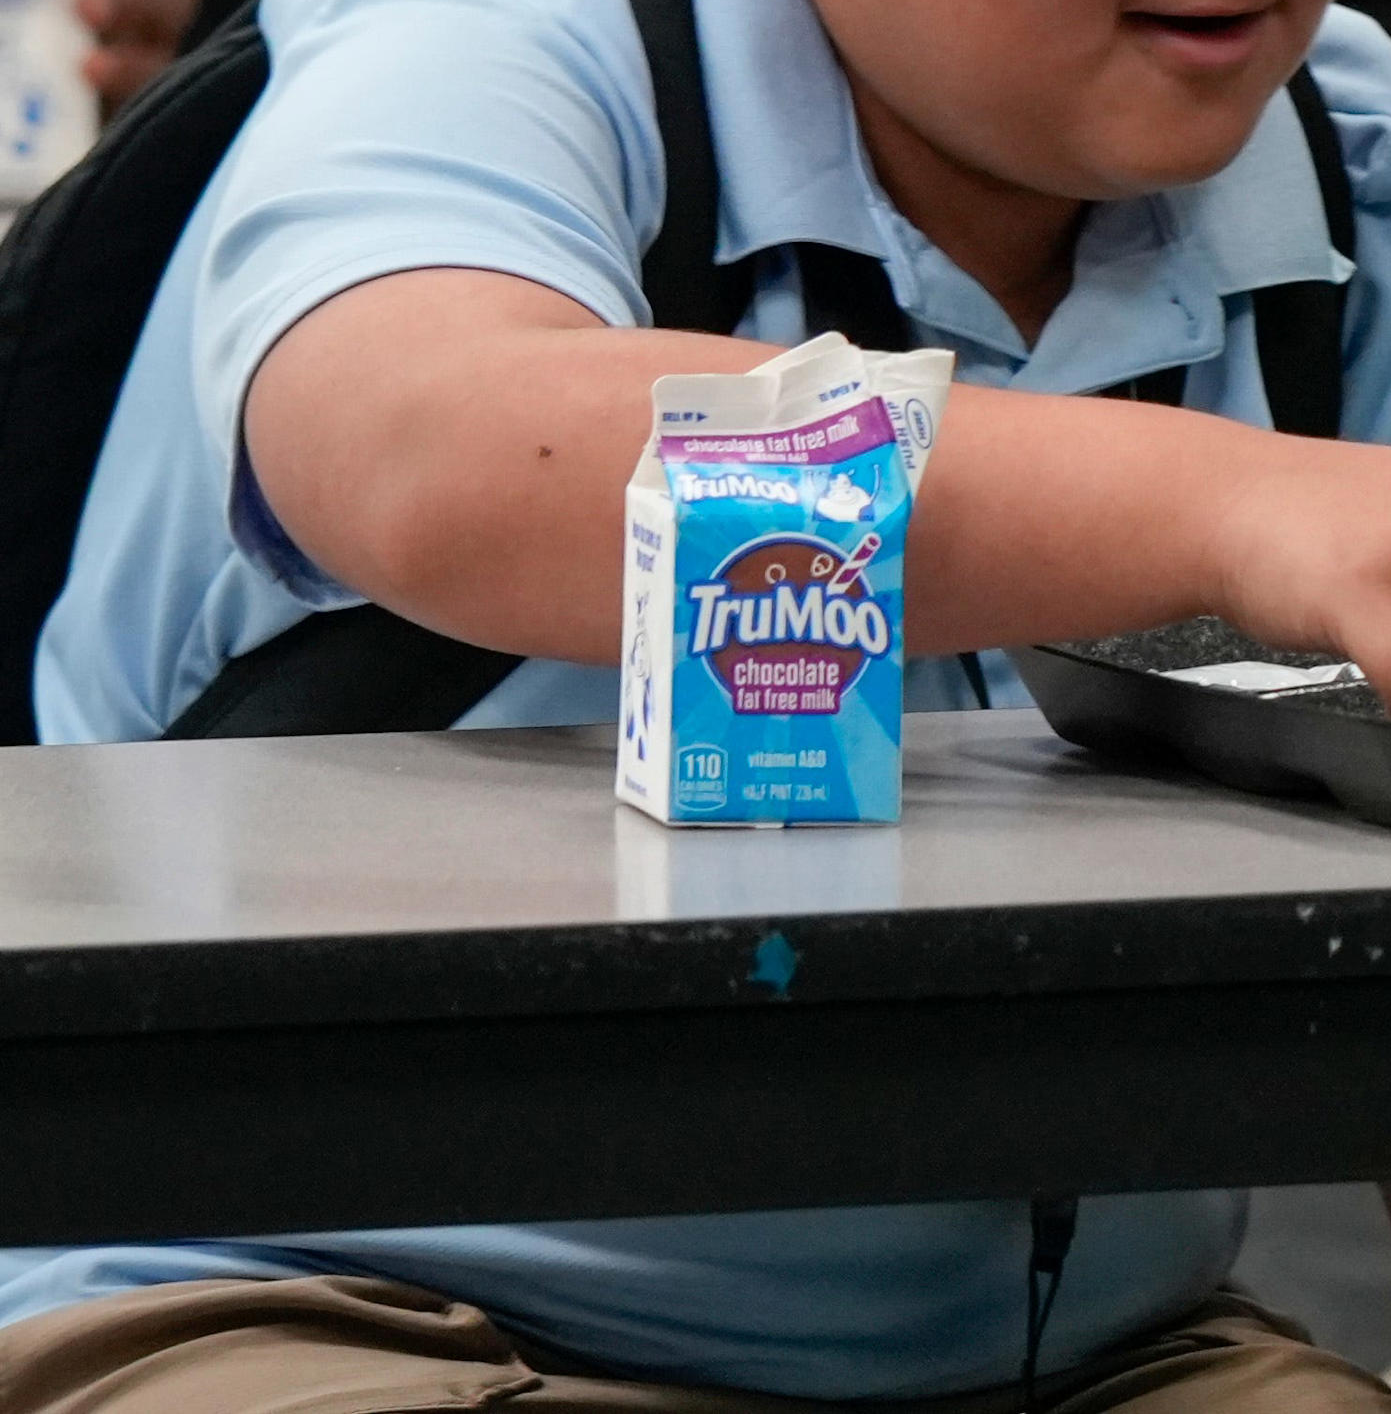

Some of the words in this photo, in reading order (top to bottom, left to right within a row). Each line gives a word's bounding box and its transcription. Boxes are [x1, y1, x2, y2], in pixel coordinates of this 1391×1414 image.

[683, 438, 765, 454] chocolate
[766, 436, 791, 453] fat
[792, 429, 827, 453] free
[828, 416, 861, 444] milk
[677, 473, 799, 505] TruMoo
[688, 583, 888, 655] TruMoo
[734, 658, 840, 687] chocolate
[736, 689, 761, 711] fat
[764, 688, 798, 711] free
[801, 689, 837, 711] milk
[684, 753, 722, 780] 110
